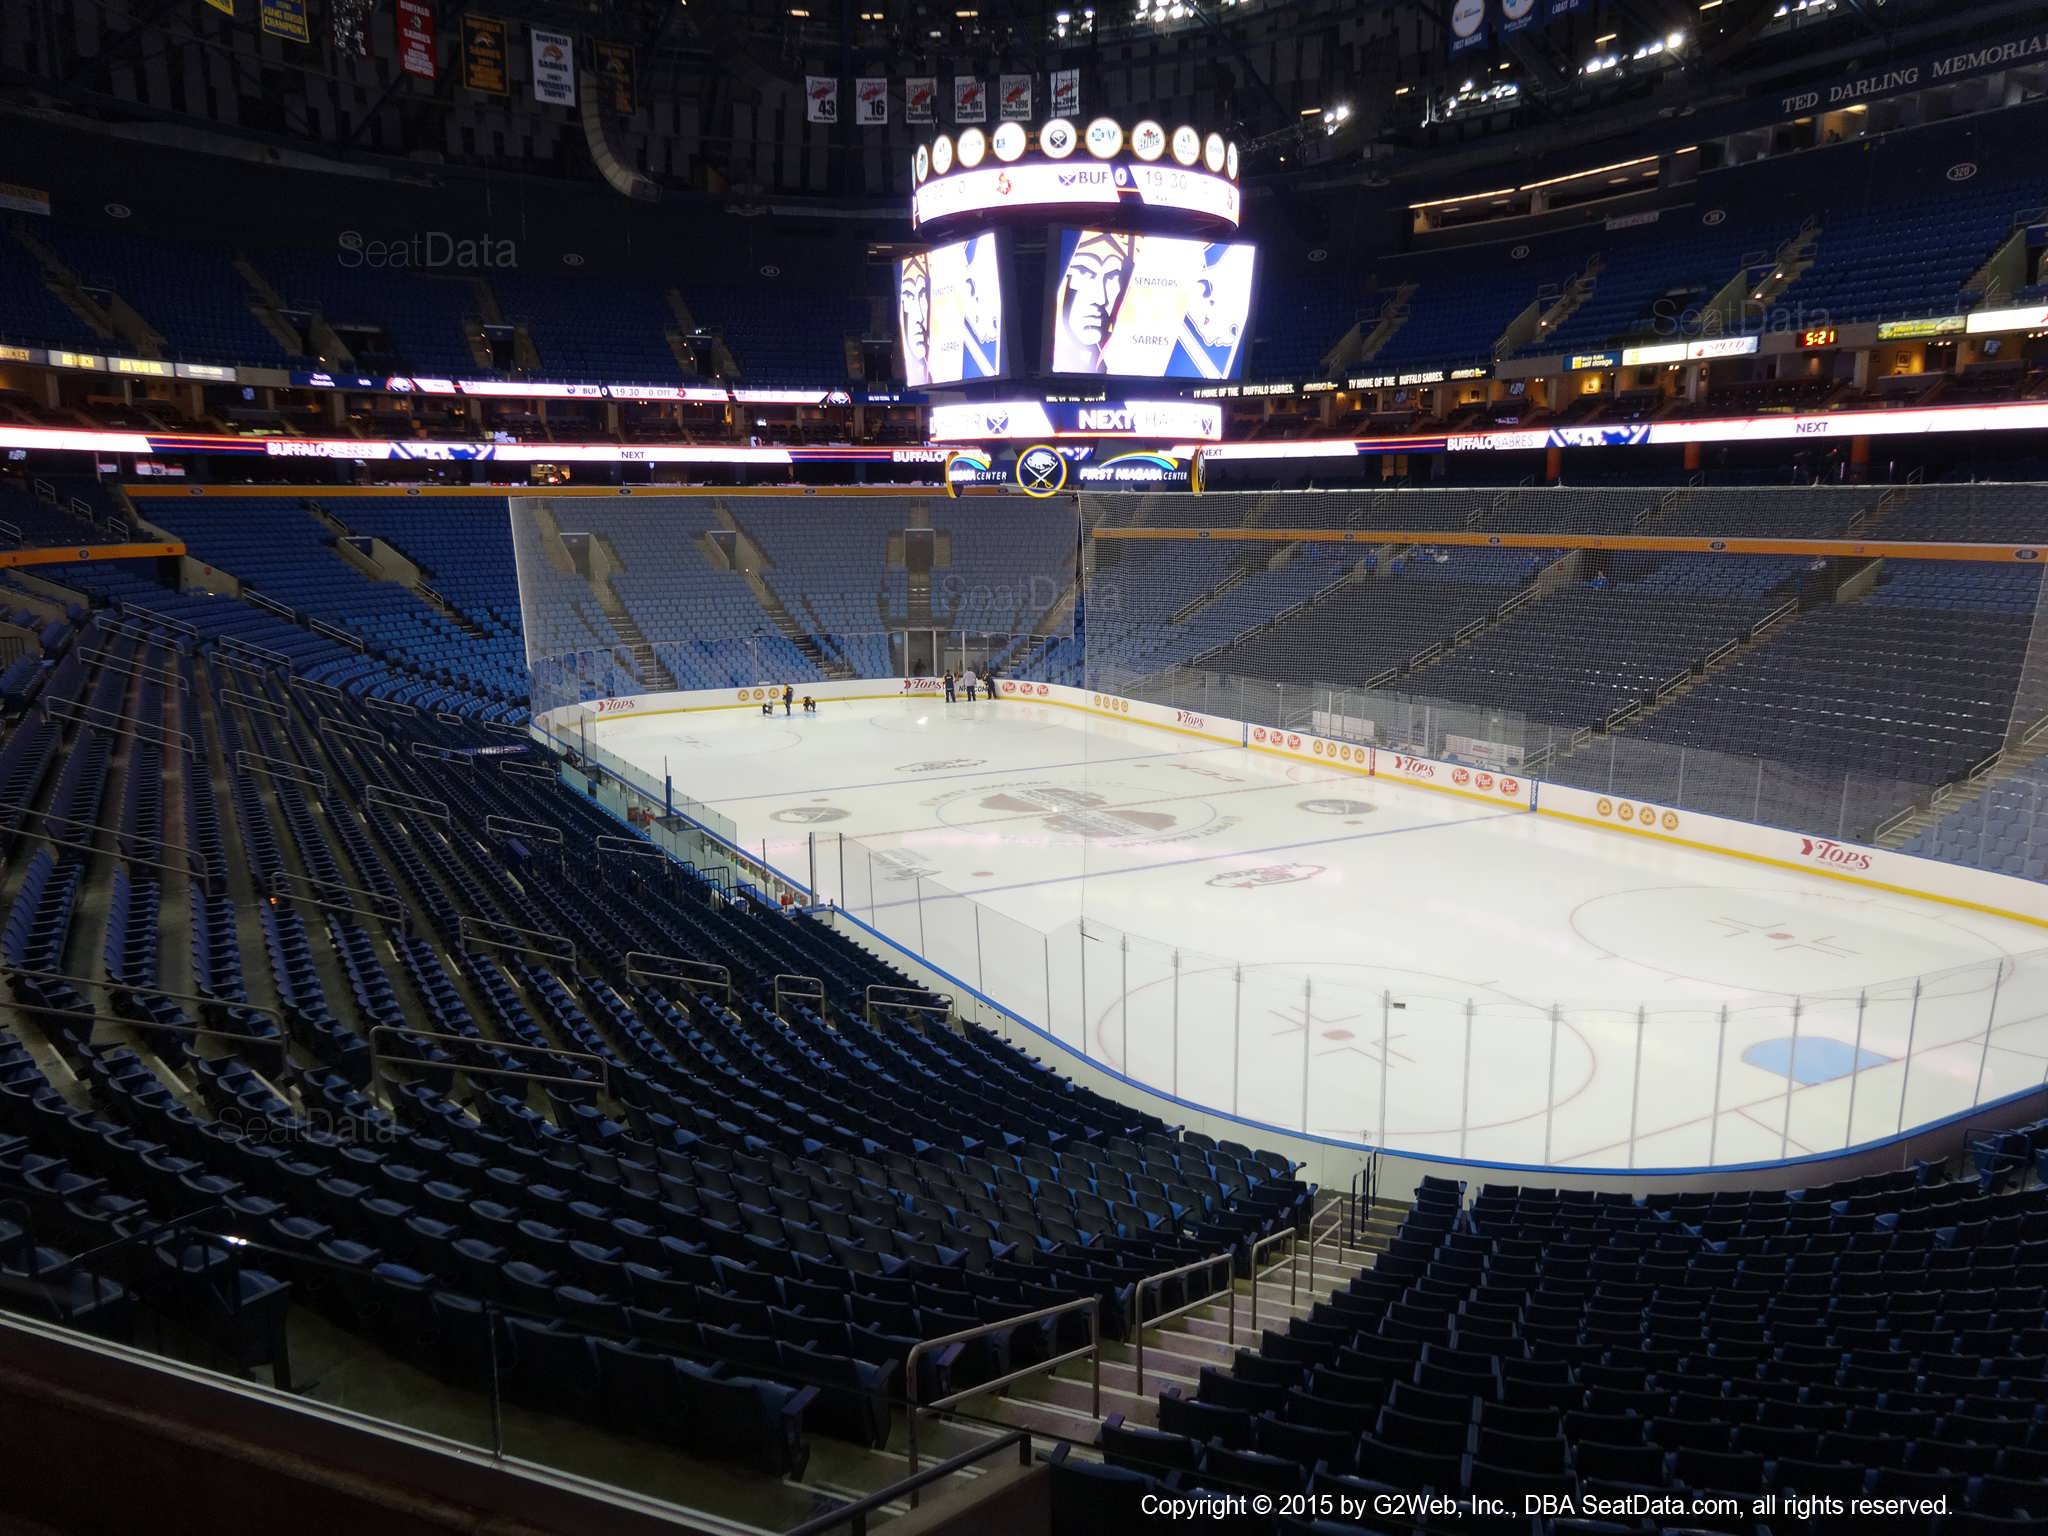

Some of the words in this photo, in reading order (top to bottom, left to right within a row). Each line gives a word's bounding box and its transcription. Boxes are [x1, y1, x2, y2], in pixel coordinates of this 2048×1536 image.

[1782, 92, 1819, 113] TED
[1828, 67, 1920, 102] DARLING
[818, 100, 835, 116] 43
[870, 100, 885, 116] 16
[1078, 171, 1109, 184] BUF
[1134, 276, 1179, 288] SENATORS
[1132, 335, 1169, 347] SABRES
[1805, 331, 1835, 346] 5:21
[1349, 380, 1356, 389] TV
[1357, 379, 1373, 388] HOME
[1374, 378, 1382, 387] OF
[1383, 376, 1395, 387] THE
[1399, 374, 1422, 385] BUFFALO
[583, 387, 598, 395] BUF
[1193, 390, 1201, 399] TV
[1201, 388, 1218, 398] HOME
[1218, 388, 1227, 397] OF
[1227, 387, 1239, 396] THE
[1242, 385, 1269, 396] BUFFALO
[1078, 410, 1128, 430] NEXT
[1796, 422, 1829, 433] NEXT
[621, 451, 645, 460] NEXT
[1202, 448, 1223, 457] NEXT
[976, 471, 1007, 482] CENTER
[1080, 467, 1113, 482] FIRST
[1115, 467, 1164, 482] NIAGARA
[1164, 471, 1187, 482] CENTER
